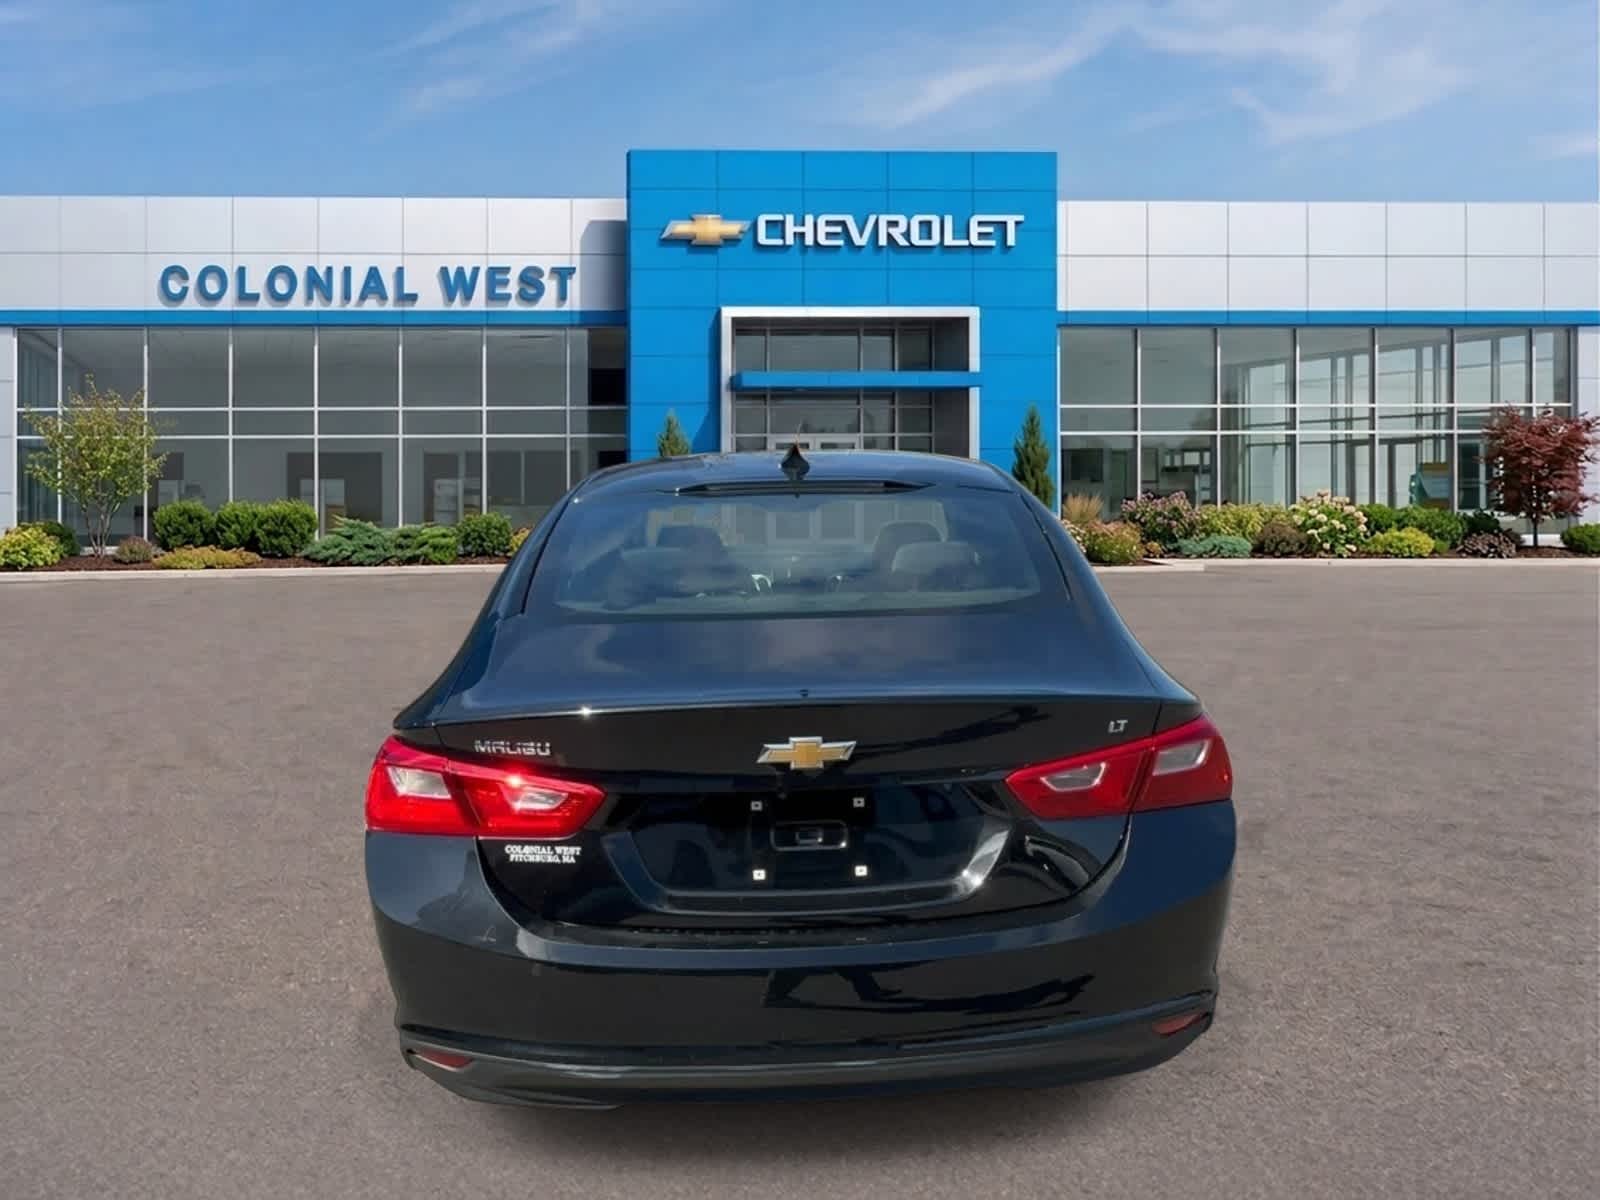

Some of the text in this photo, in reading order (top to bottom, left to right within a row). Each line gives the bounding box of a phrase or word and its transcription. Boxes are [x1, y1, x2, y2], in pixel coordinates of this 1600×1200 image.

[757, 214, 1025, 247] CHEVROLET
[160, 264, 577, 304] COLONIAL WEST
[1108, 719, 1129, 733] LT
[474, 740, 551, 756] MALIBU
